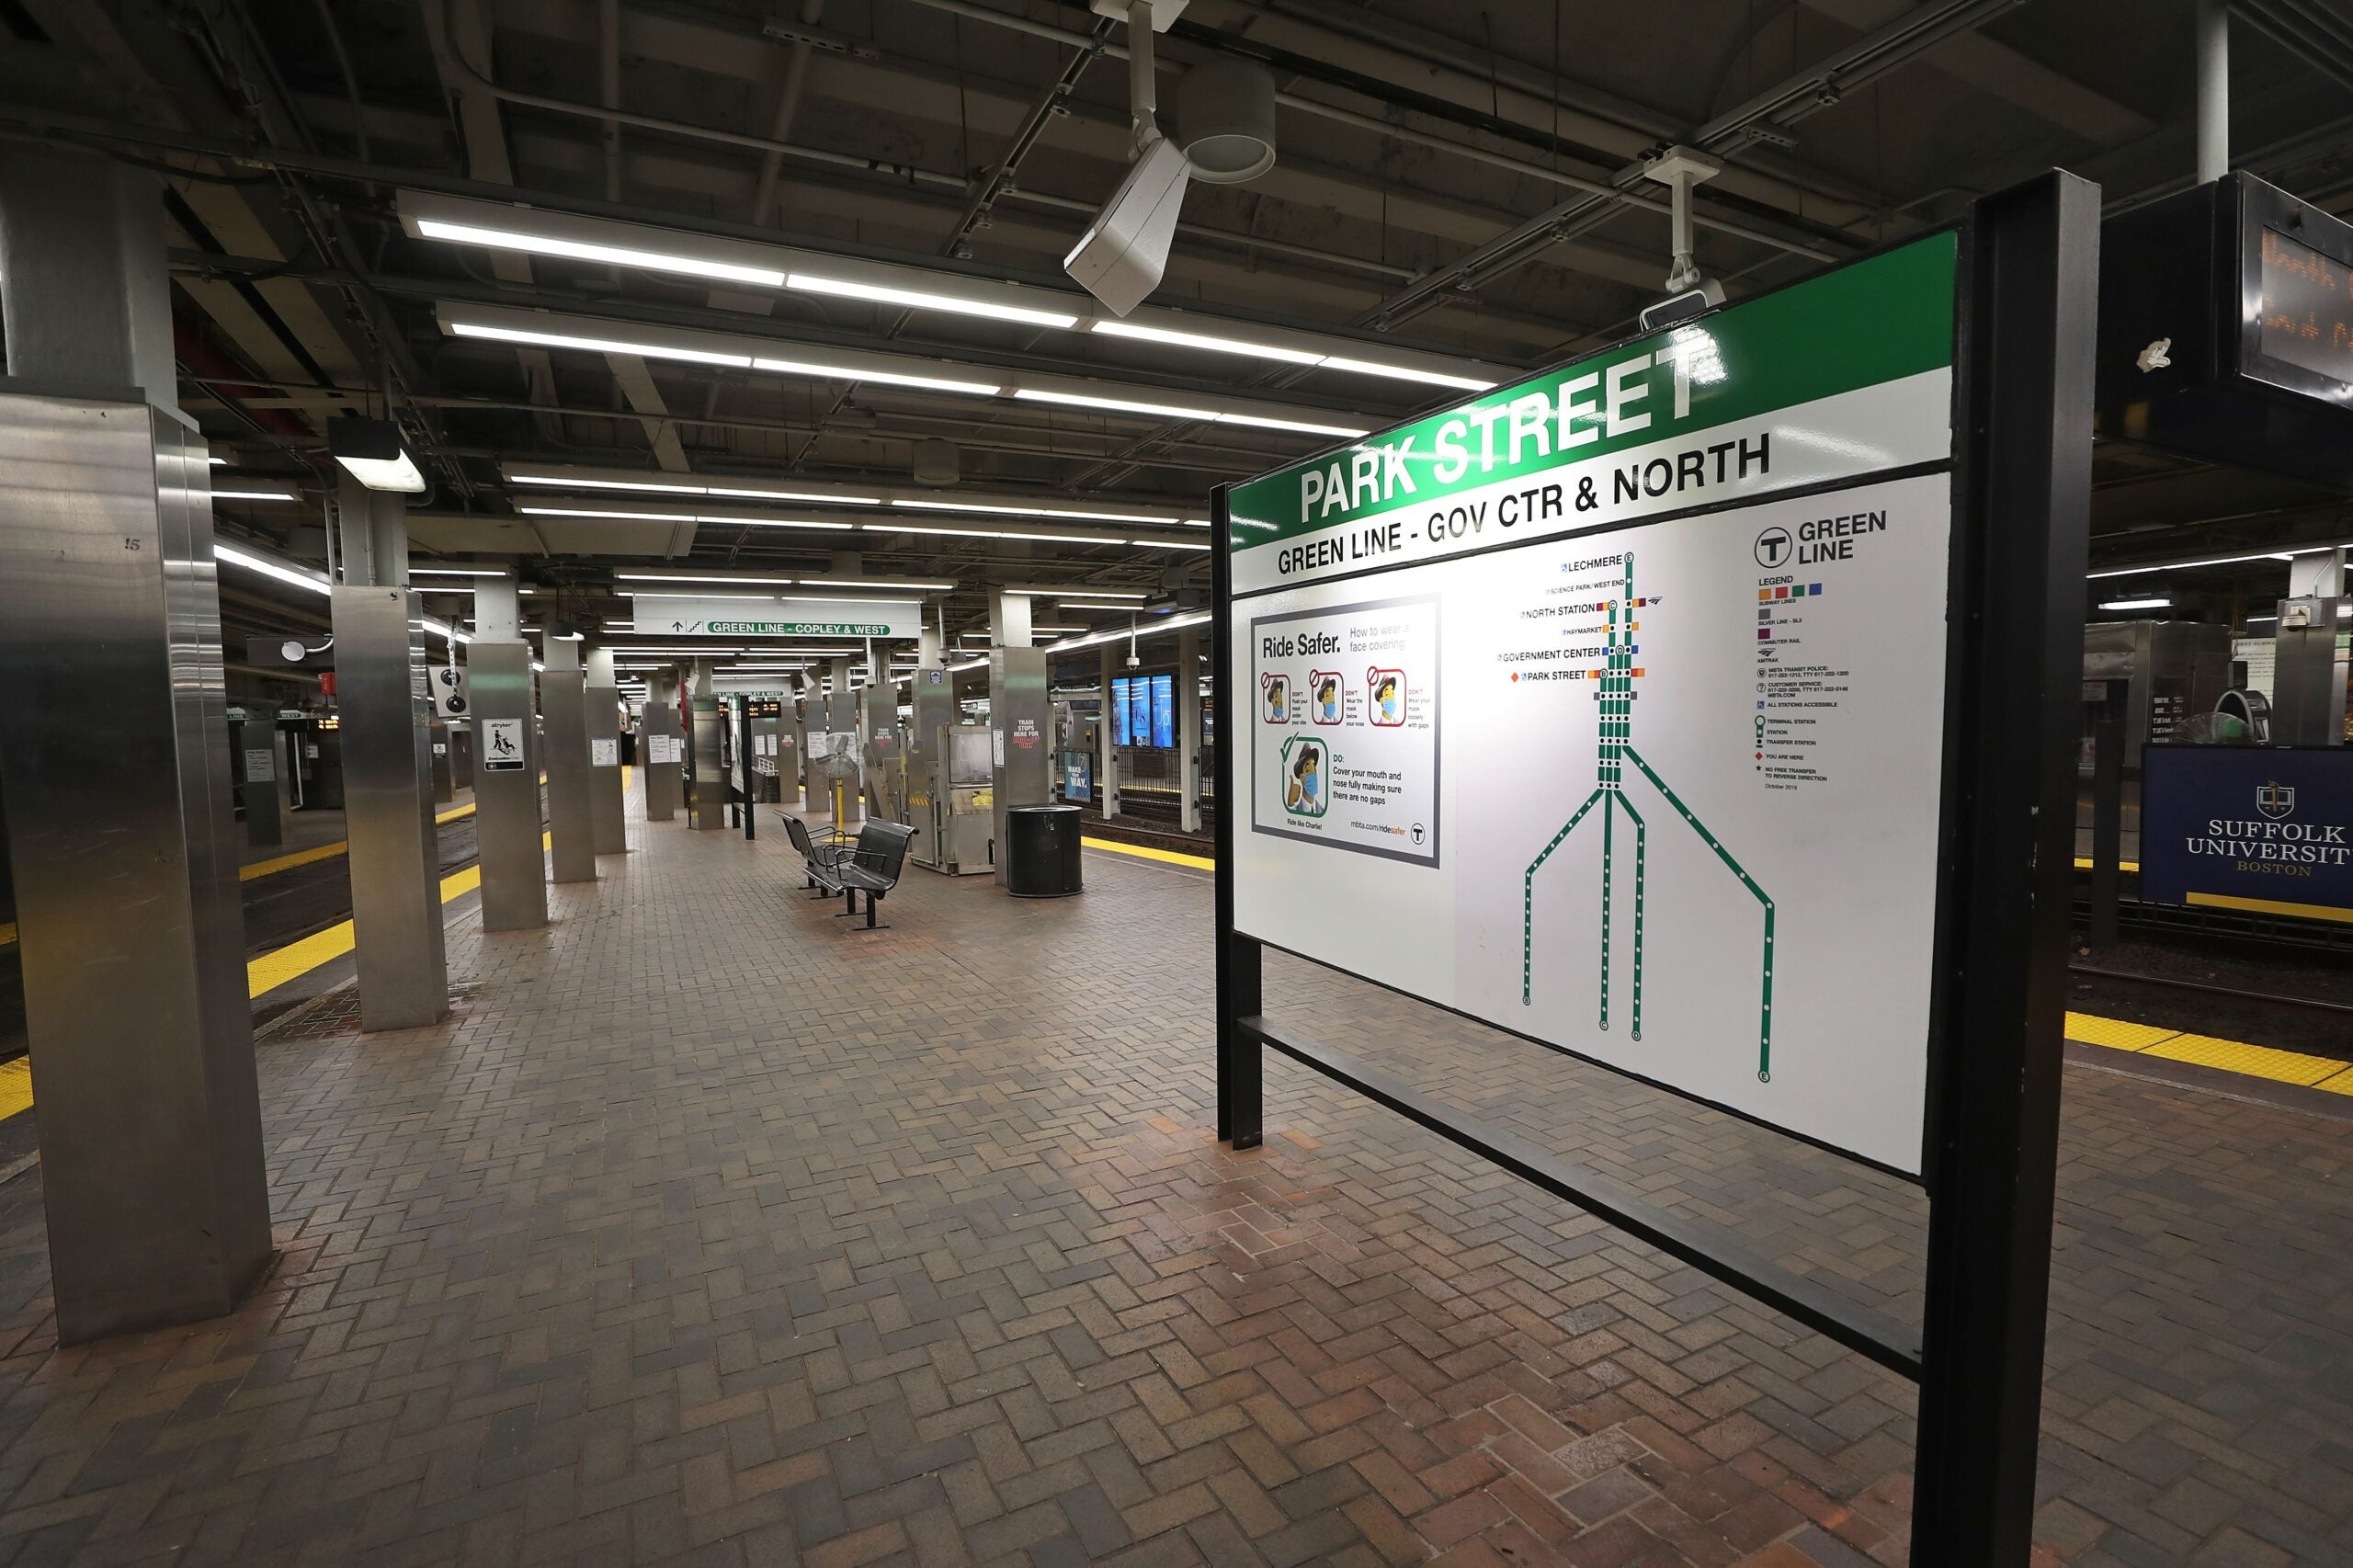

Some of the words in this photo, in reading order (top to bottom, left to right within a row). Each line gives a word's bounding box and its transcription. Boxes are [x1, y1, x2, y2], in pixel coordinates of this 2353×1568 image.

[1302, 435, 1417, 524] PARK
[1433, 335, 1709, 484] STREET
[1279, 536, 1344, 574] GREEN
[1352, 522, 1402, 560] LINE
[1428, 501, 1486, 542] GOV
[1498, 483, 1563, 528] CTR
[1574, 476, 1599, 512] &
[1613, 432, 1769, 505] NORTH
[1799, 510, 1886, 542] GREEN
[1799, 539, 1854, 564] LINE
[1568, 554, 1623, 572] LECHMERE
[1551, 585, 1574, 595] SCIENCE
[1575, 580, 1610, 591] PARK/WEST
[1612, 579, 1625, 587] END
[1758, 575, 1793, 586] LEGEND
[1526, 608, 1556, 619] NORTH
[1558, 603, 1595, 616] STATION
[712, 622, 756, 633] GREEN
[757, 623, 785, 633] LINE
[795, 624, 841, 634] COPLEY
[843, 625, 851, 634] &
[854, 625, 886, 635] WEST
[1349, 627, 1368, 639] How
[1370, 626, 1379, 636] to
[1381, 626, 1402, 635] wear
[1566, 626, 1602, 635] HAYMARKET
[1263, 634, 1294, 658] Ride
[1297, 631, 1341, 656] Safer.
[1349, 642, 1368, 653] face
[1503, 650, 1561, 662] GOVERNMENT
[1563, 647, 1600, 658] CENTER
[1528, 672, 1551, 680] PARK
[1552, 670, 1586, 680] STREET
[1334, 755, 1345, 763] DO:
[1333, 767, 1350, 776] Cover
[1351, 769, 1365, 778] your
[1367, 769, 1387, 779] mouth
[1389, 771, 1402, 780] and
[1070, 777, 1087, 789] WAY.
[1333, 780, 1347, 789] nose
[1348, 780, 1361, 790] fully
[1362, 782, 1385, 793] making
[1387, 786, 1402, 794] sure
[1333, 791, 1348, 801] there
[1370, 796, 1386, 806] gaps
[1288, 818, 1297, 826] Ride
[1297, 819, 1305, 827] like
[1350, 820, 1406, 835] mbta.com/ridesafer
[2209, 819, 2346, 844] SUFFOLK
[2186, 837, 2353, 865] UNIVERSIT
[2236, 860, 2313, 877] BOSTON
